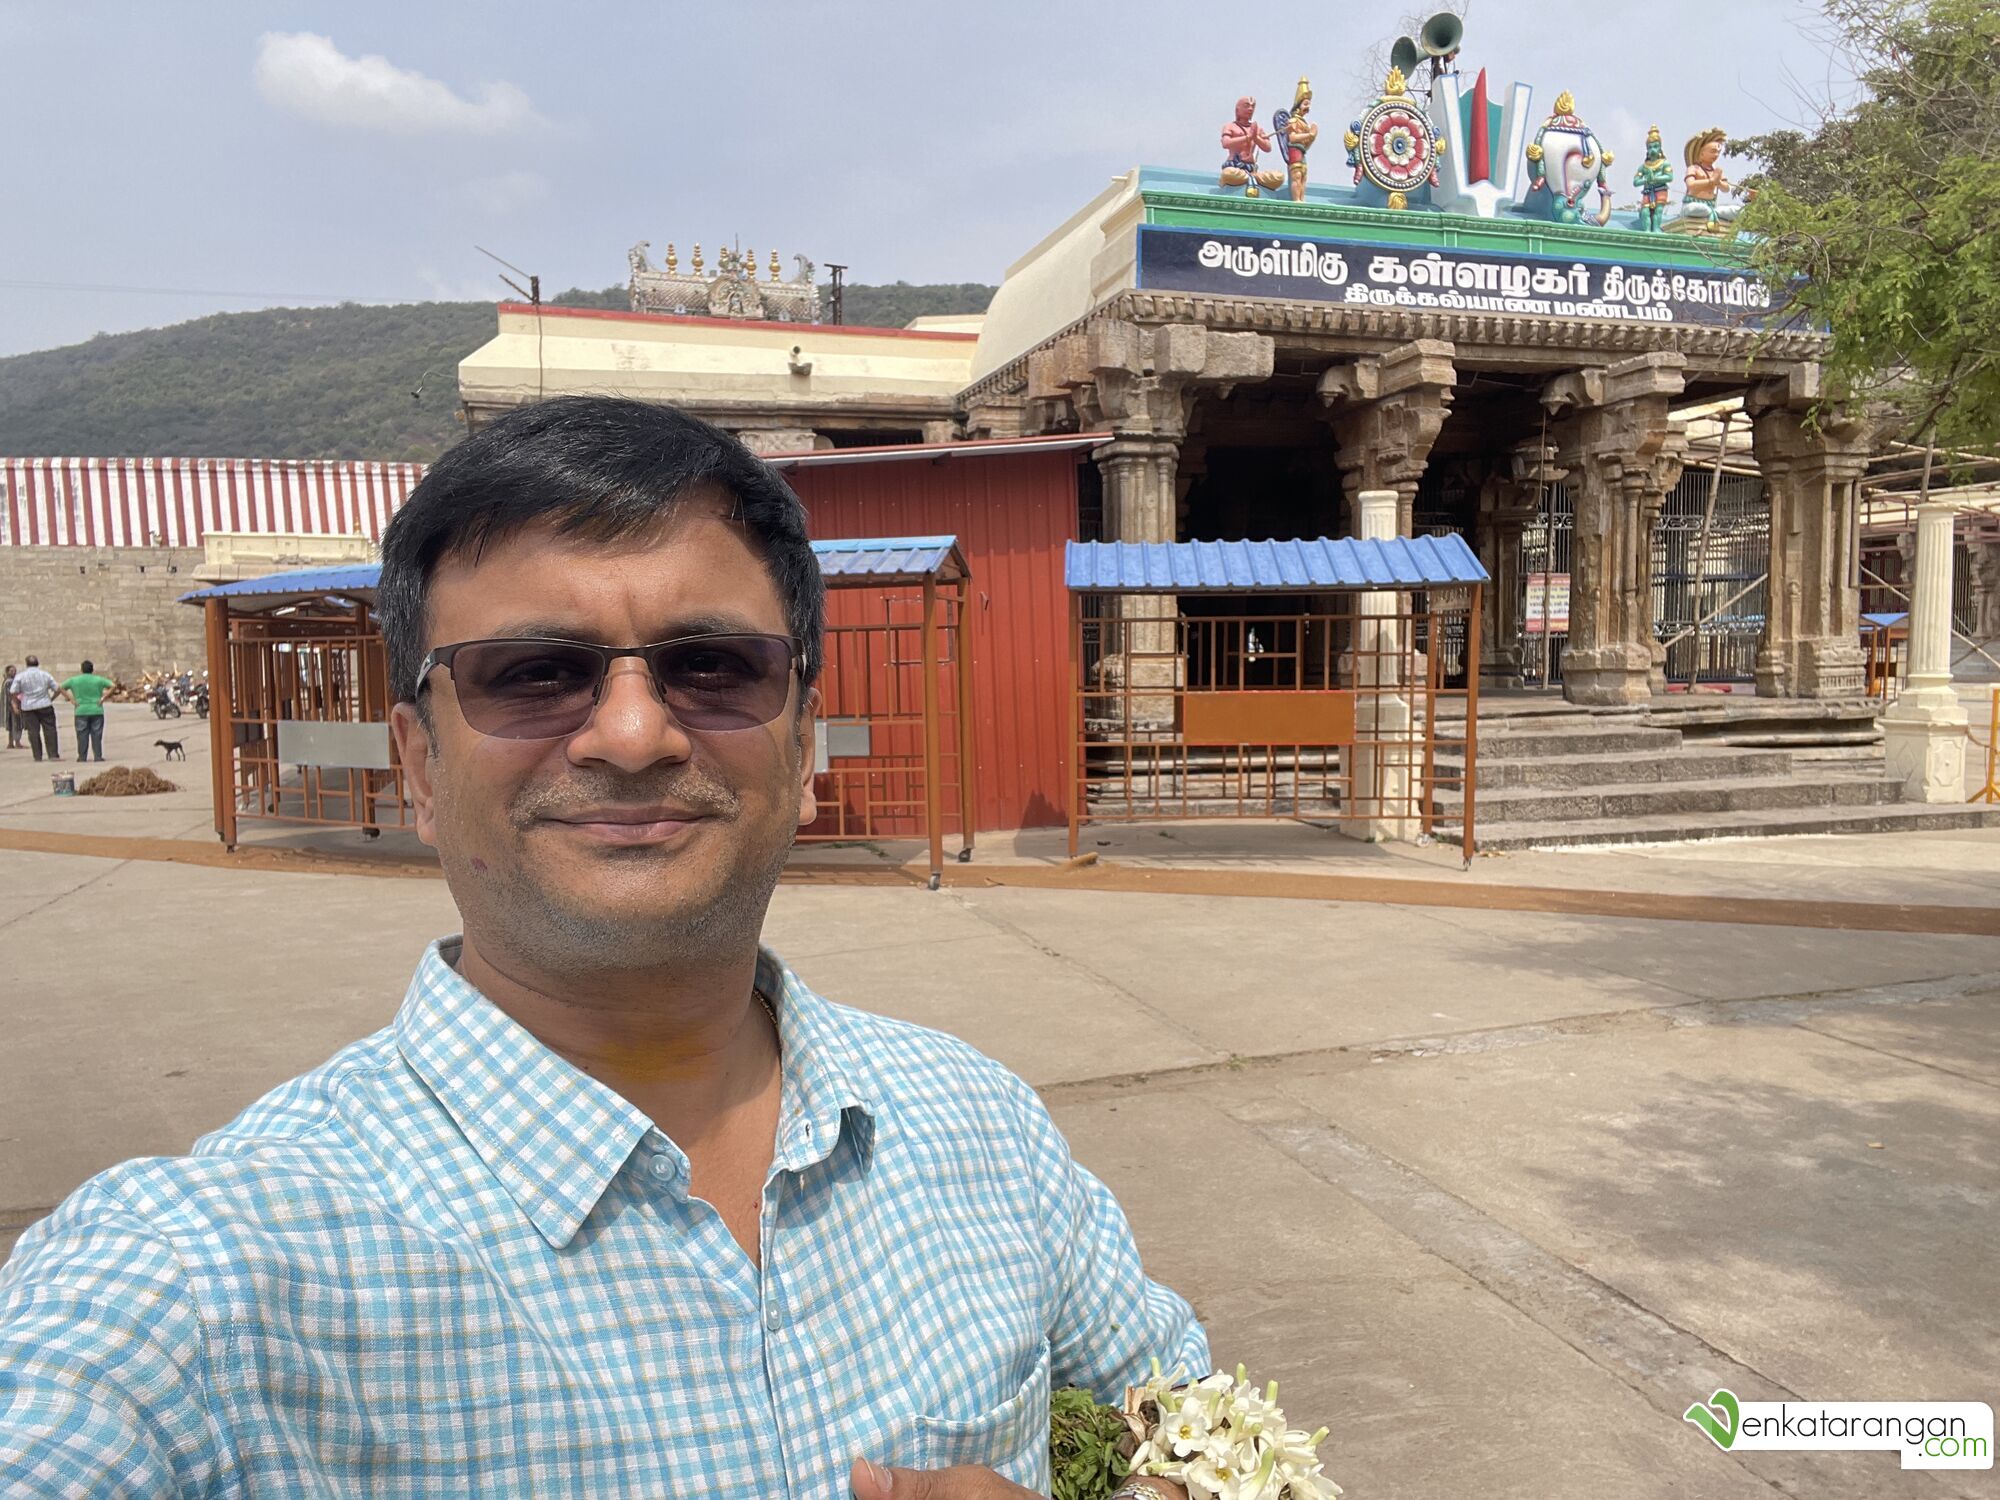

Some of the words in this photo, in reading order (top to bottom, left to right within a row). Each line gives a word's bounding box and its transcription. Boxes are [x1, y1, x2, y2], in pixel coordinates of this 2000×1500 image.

[1197, 239, 1349, 285] அருள்மிகு
[1368, 252, 1591, 298] கள்ளழகர்
[1602, 265, 1771, 309] திருக்கோயில்
